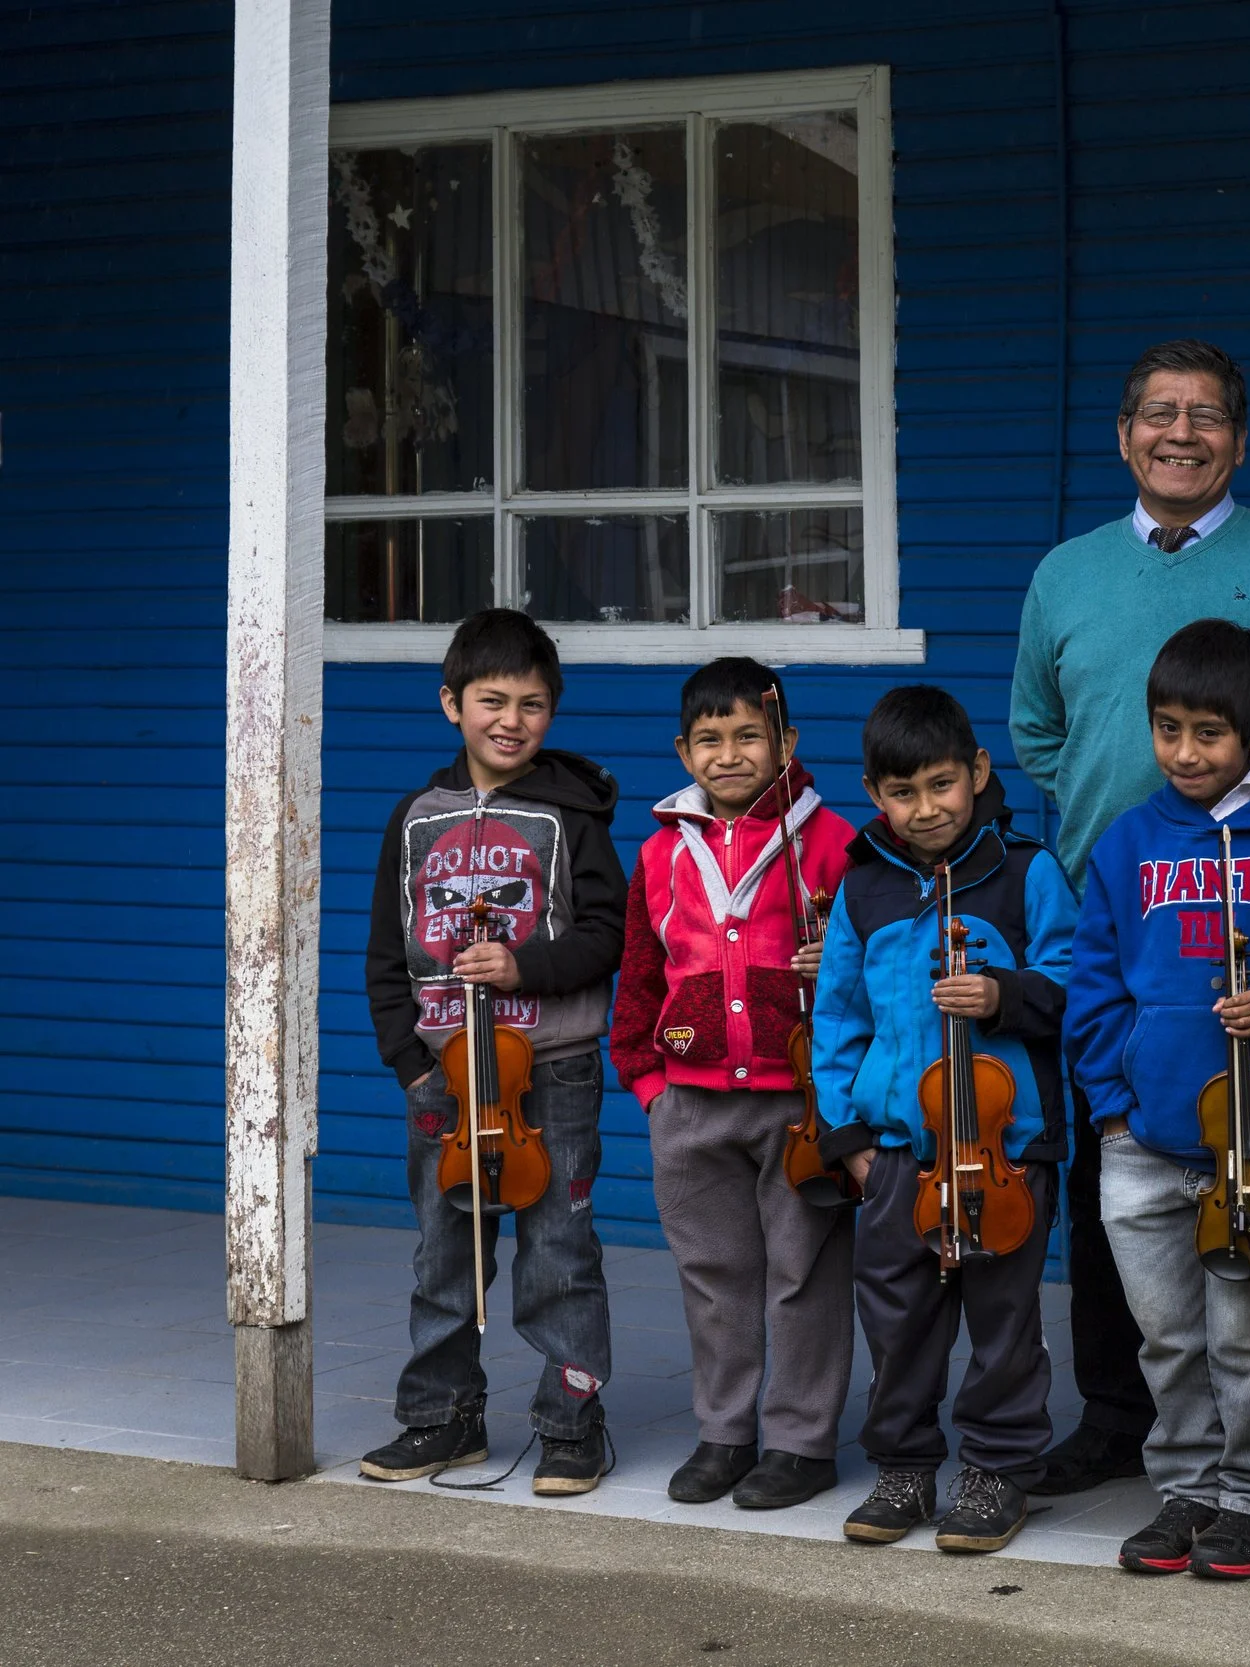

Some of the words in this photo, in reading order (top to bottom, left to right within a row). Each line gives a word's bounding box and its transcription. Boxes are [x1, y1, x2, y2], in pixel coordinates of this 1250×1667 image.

[426, 847, 463, 878] DO
[469, 845, 530, 874] NOT
[491, 994, 536, 1023] nly
[667, 1029, 692, 1040] JIEBAO
[673, 1039, 686, 1050] 89
